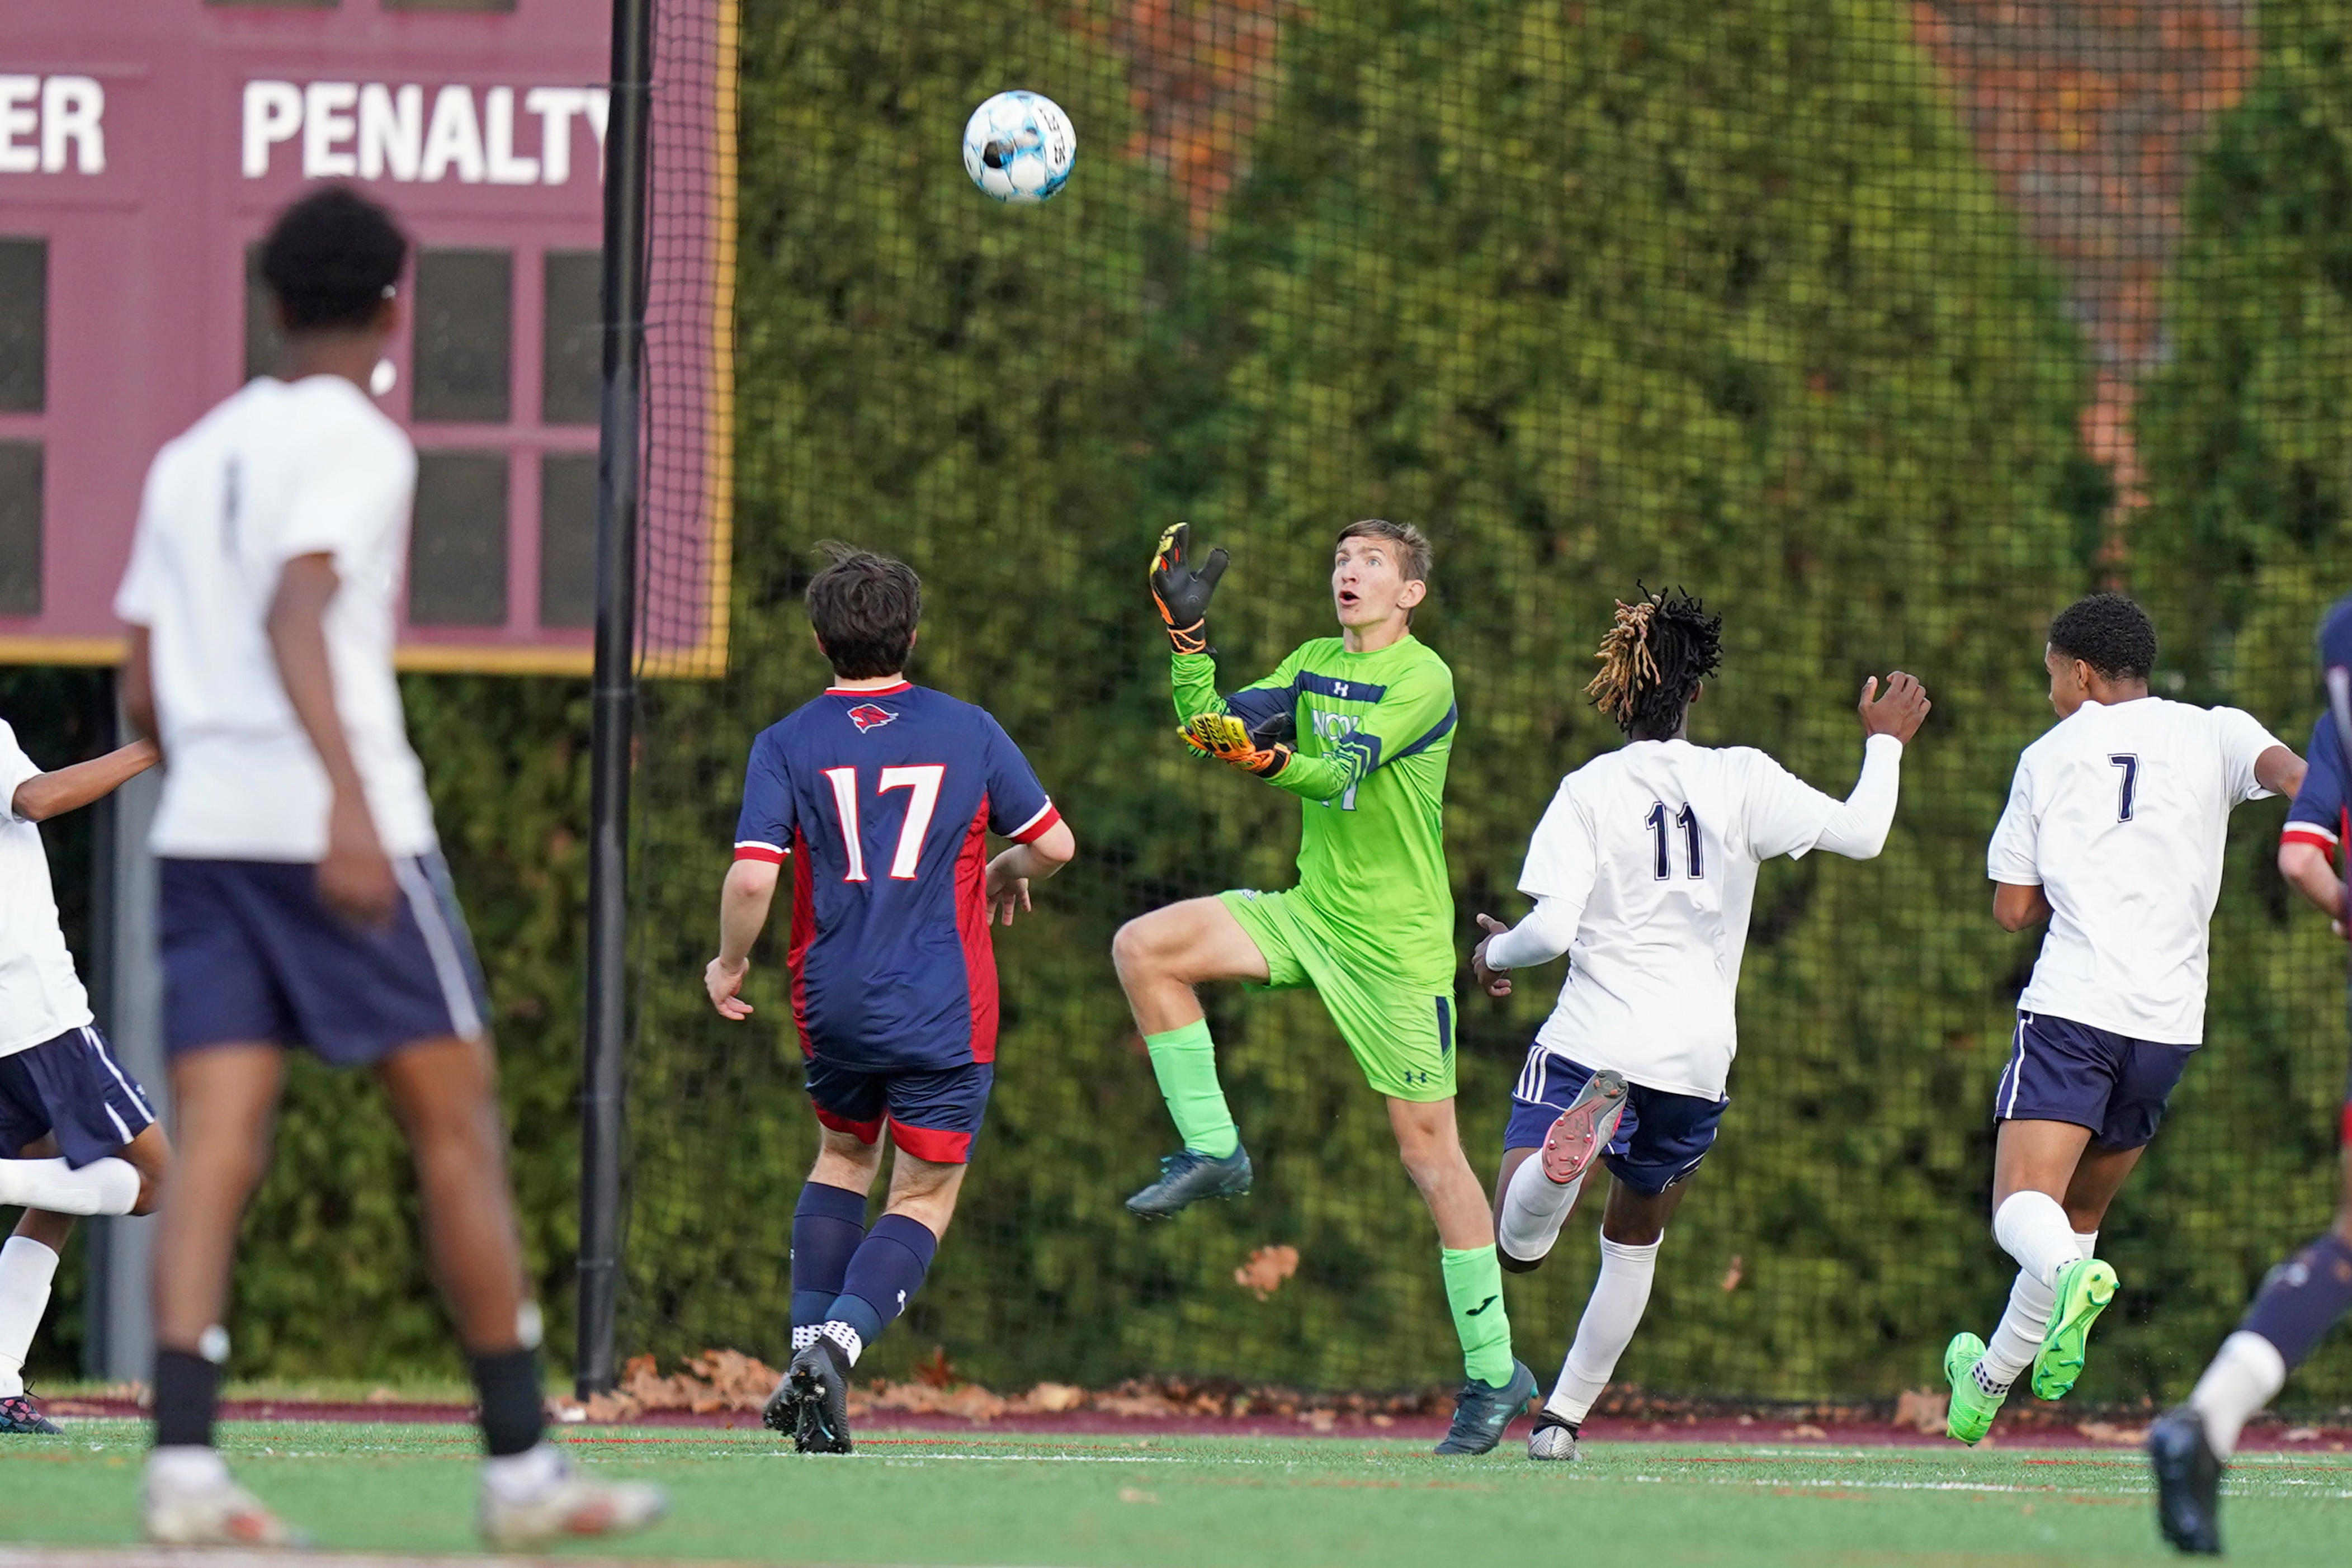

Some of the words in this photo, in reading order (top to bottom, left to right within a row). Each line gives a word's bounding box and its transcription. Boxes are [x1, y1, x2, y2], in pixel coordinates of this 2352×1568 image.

[0, 73, 107, 175] ER
[819, 763, 947, 883] 17
[2108, 753, 2140, 823] 7
[1644, 801, 1704, 881] 11
